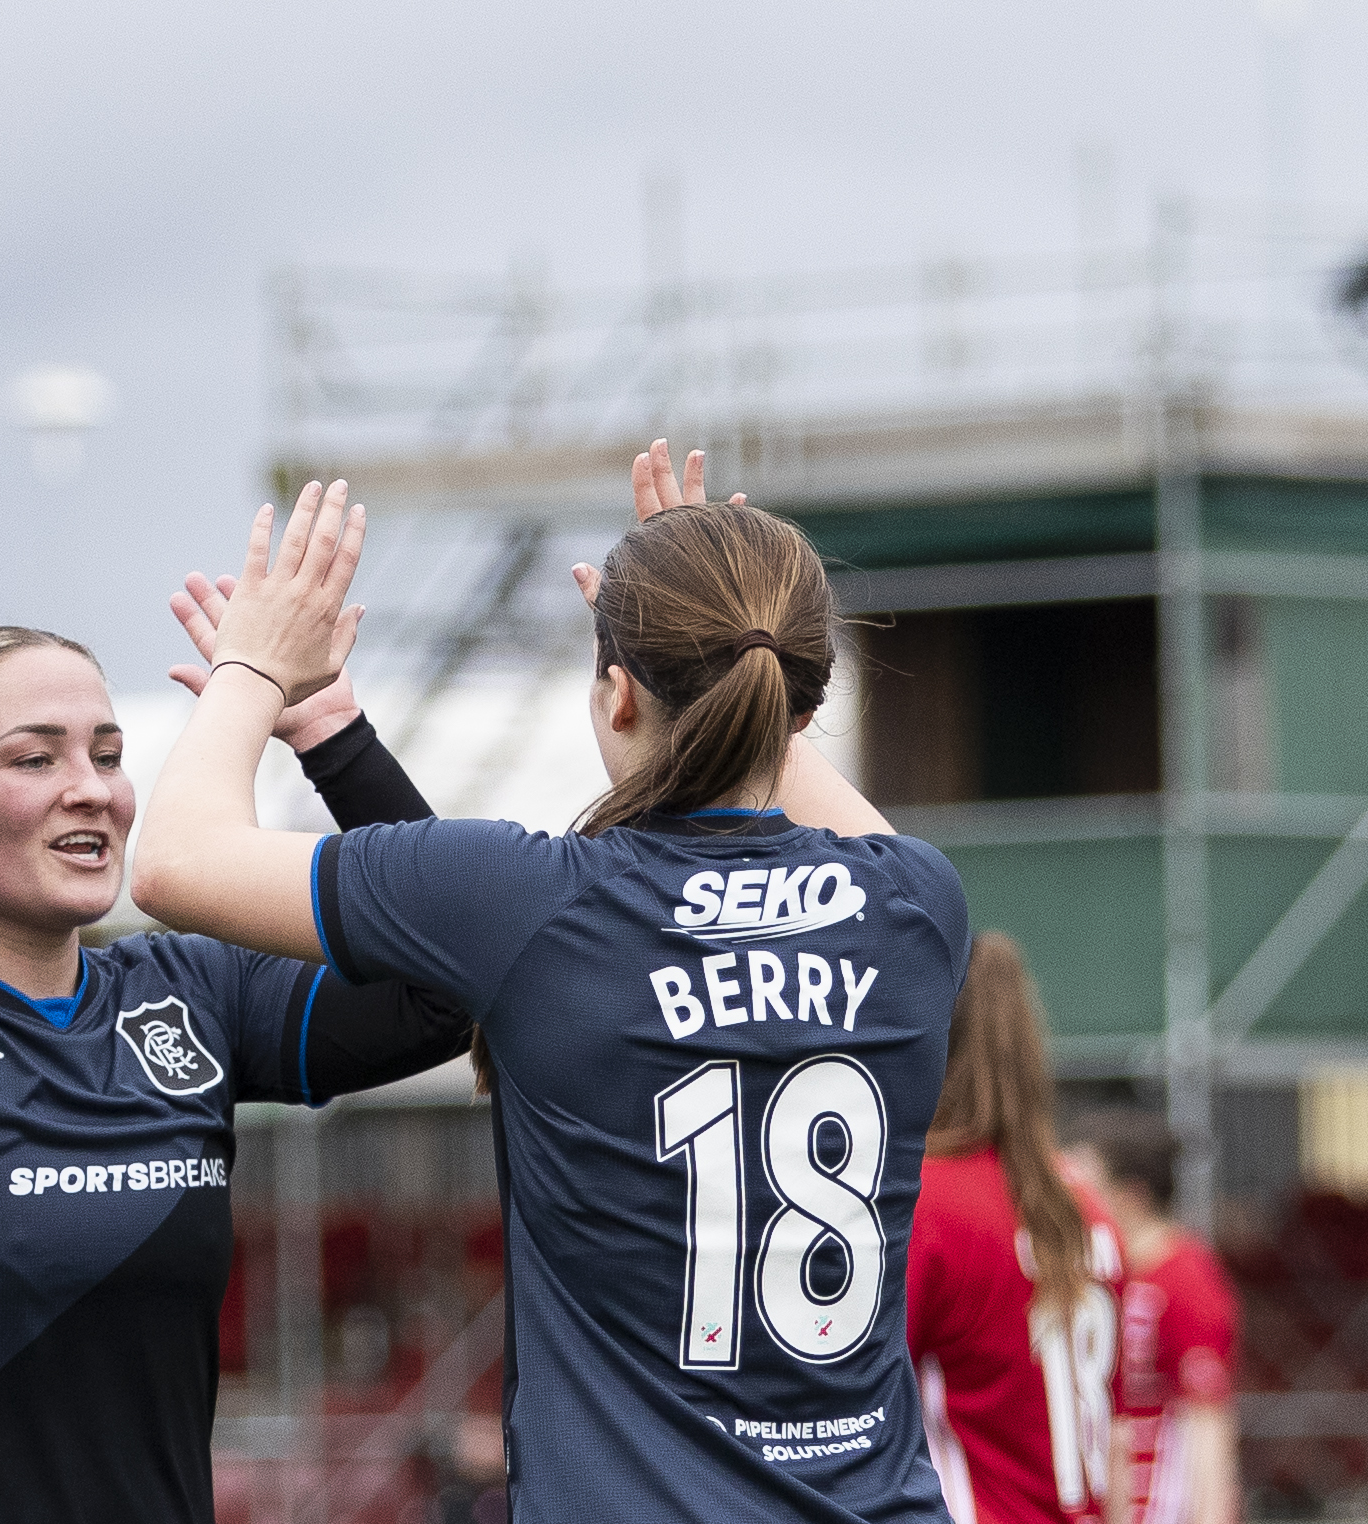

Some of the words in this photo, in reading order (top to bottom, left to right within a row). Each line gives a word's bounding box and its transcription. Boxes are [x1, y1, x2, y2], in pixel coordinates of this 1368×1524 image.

[674, 862, 866, 927] SEKO
[648, 950, 879, 1040] BERRY
[654, 1053, 888, 1371] 18
[734, 1418, 814, 1440] PIPELINE
[817, 1406, 885, 1438] ENERGY
[762, 1435, 872, 1462] SOLUTIONS
